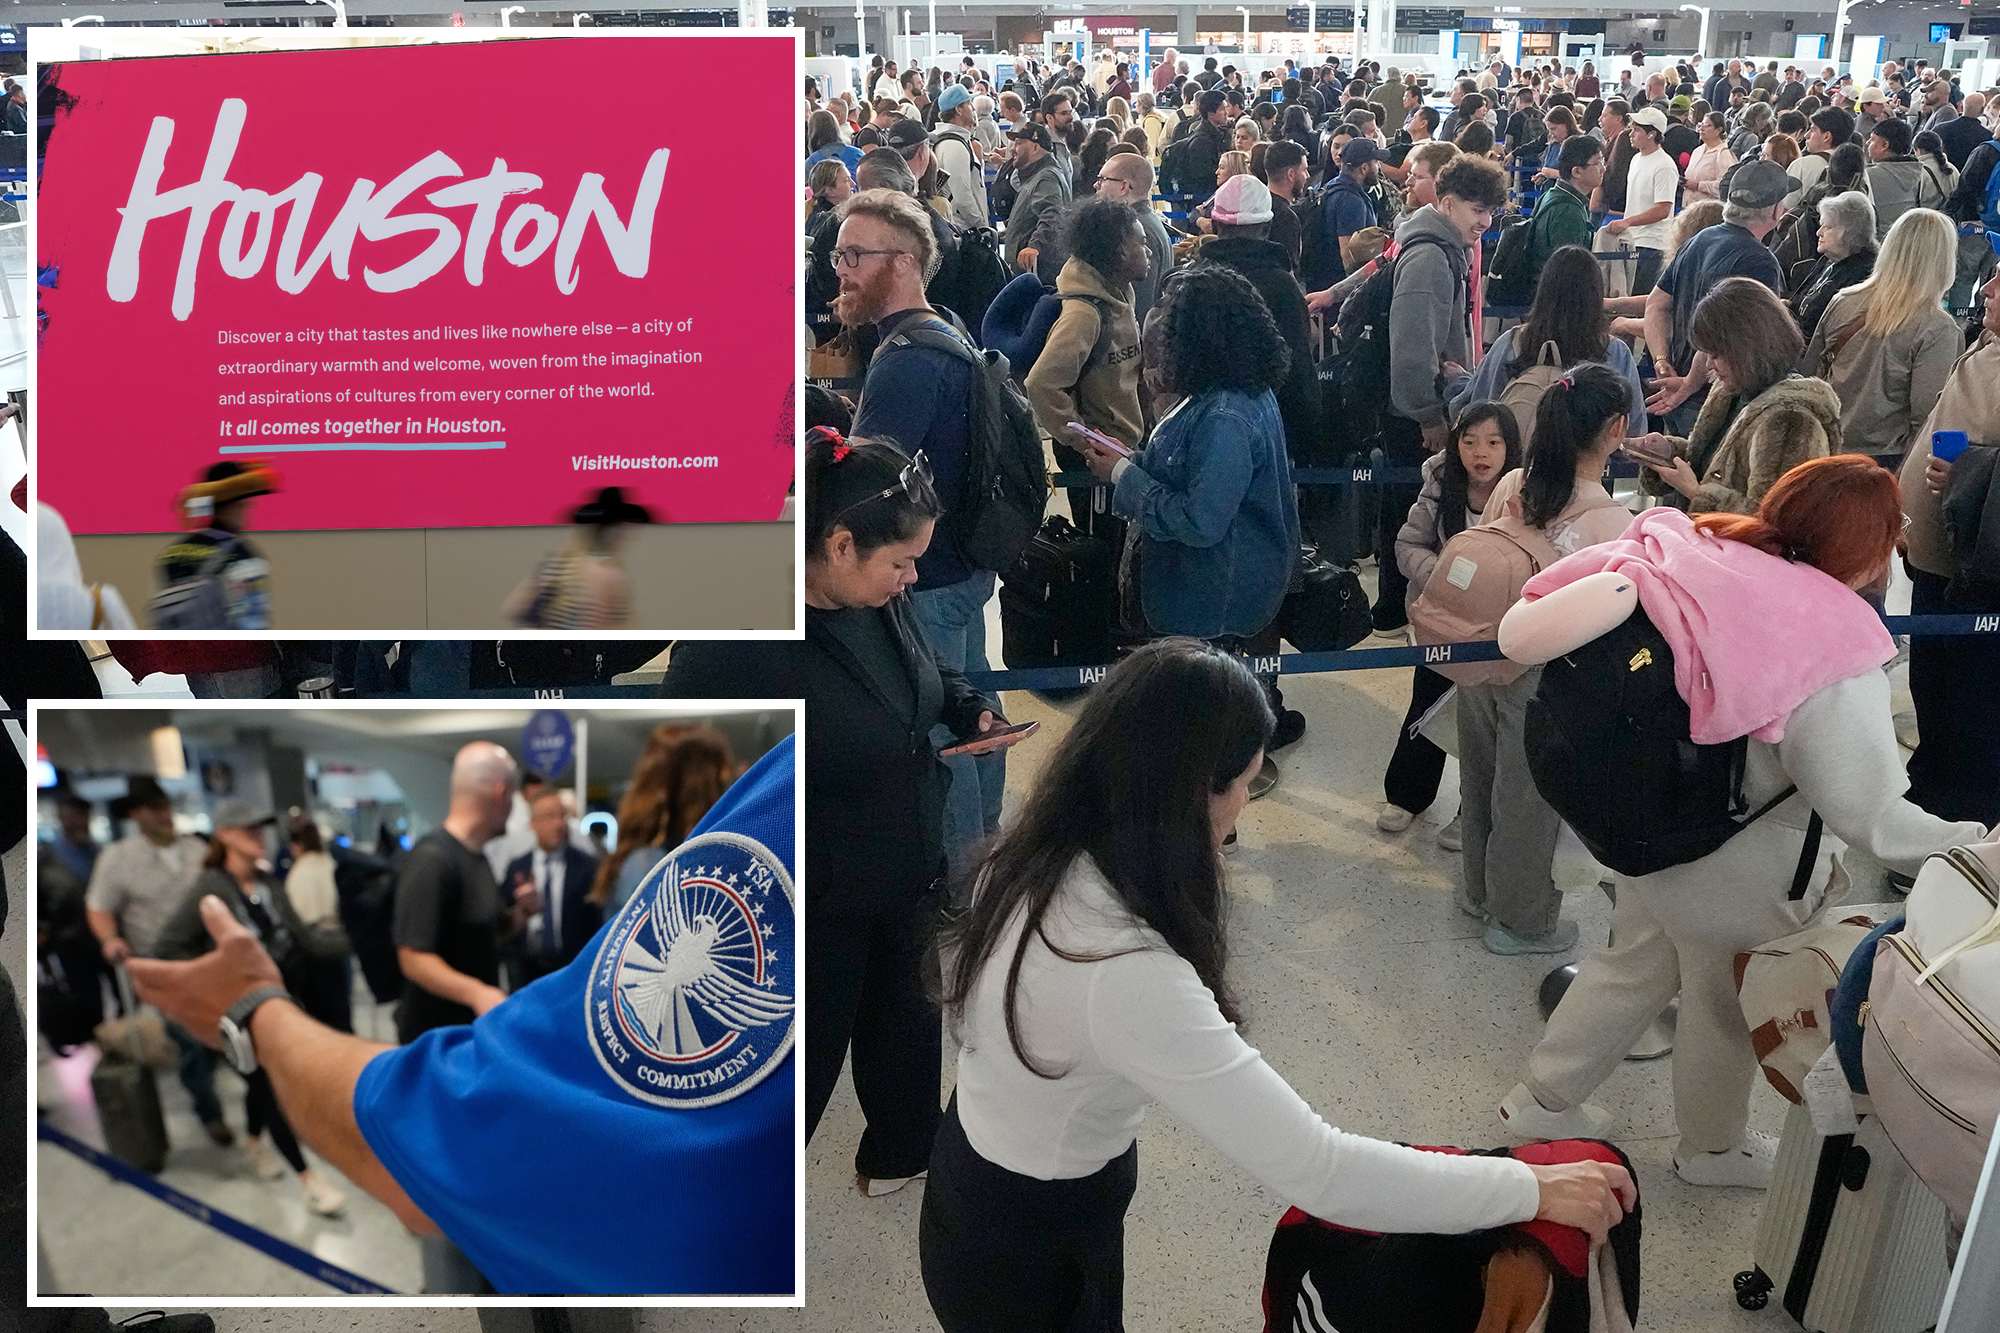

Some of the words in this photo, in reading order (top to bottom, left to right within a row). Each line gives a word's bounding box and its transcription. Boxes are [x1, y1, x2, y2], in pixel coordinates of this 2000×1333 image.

[1629, 251, 1640, 259] IAH
[817, 314, 830, 322] IAH
[218, 330, 282, 345] Discover
[284, 331, 294, 343] a
[297, 327, 325, 345] city
[327, 327, 359, 342] that
[361, 327, 410, 341] tastes
[412, 326, 440, 341] and
[443, 325, 479, 340] lives
[482, 324, 508, 339] like
[511, 322, 578, 338] nowhere
[581, 321, 613, 336] else
[631, 322, 641, 334] a
[644, 318, 673, 336] city
[676, 317, 693, 332] of
[218, 359, 318, 376] extraordinary
[321, 357, 379, 372] warmth
[382, 357, 410, 372] and
[413, 356, 485, 372] welcome,
[488, 357, 538, 370] woven
[541, 354, 578, 368] from
[581, 352, 608, 367] the
[611, 349, 703, 368] imagination
[817, 379, 833, 388] IAH
[1318, 371, 1333, 380] IAH
[218, 390, 246, 406] and
[249, 389, 332, 408] aspirations
[335, 388, 351, 403] of
[354, 388, 417, 403] cultures
[419, 388, 456, 402] from
[459, 390, 502, 405] every
[504, 388, 556, 401] corner
[559, 384, 575, 399] of
[578, 383, 604, 398] the
[607, 381, 655, 397] world.
[219, 420, 233, 437] It
[236, 419, 258, 437] all
[260, 421, 321, 436] comes
[324, 417, 403, 438] together
[406, 416, 422, 434] in
[426, 416, 507, 435] Houston.
[571, 454, 719, 471] VisitHouston.com
[1352, 469, 1372, 481] IAH
[1974, 616, 1999, 632] IAH
[1425, 645, 1451, 663] IAH
[1255, 656, 1281, 673] IAH
[1079, 667, 1107, 684] IAH
[744, 856, 774, 896] TSA
[600, 898, 646, 987] INTEGRITY
[598, 1000, 631, 1064] RESPECT
[637, 1044, 759, 1090] COMMITMENT
